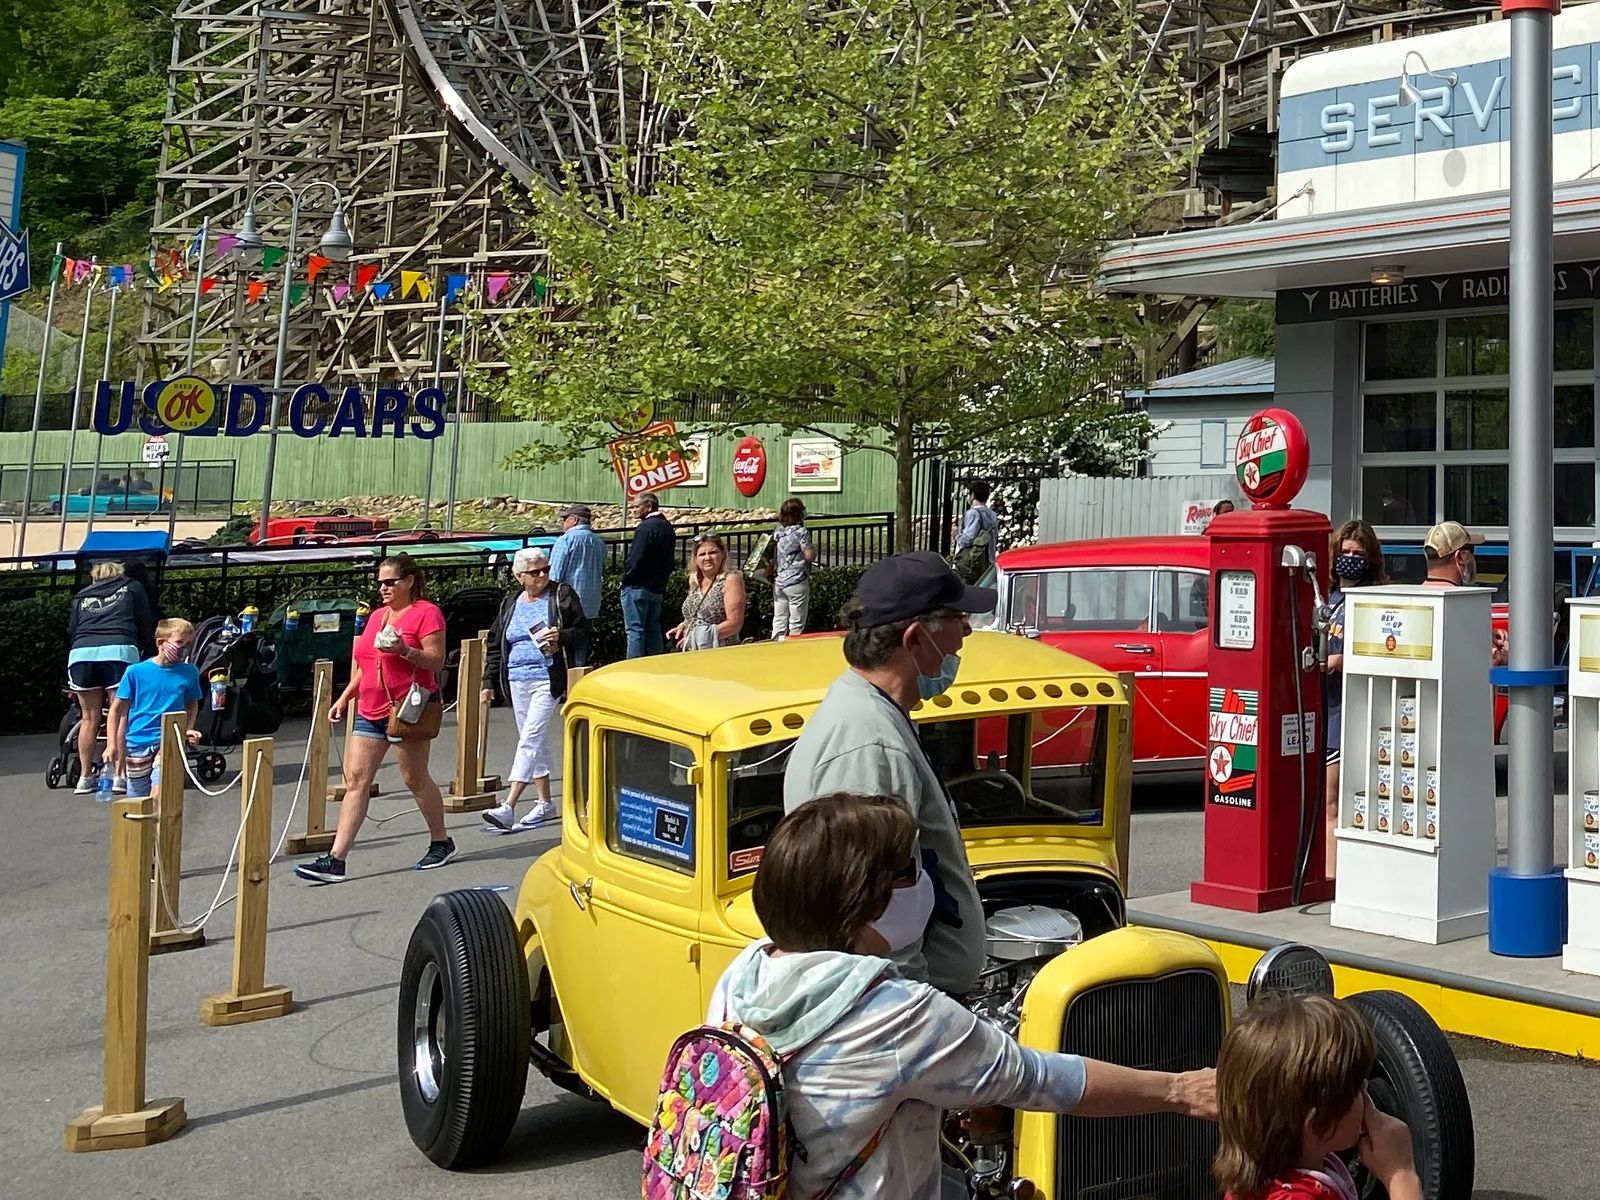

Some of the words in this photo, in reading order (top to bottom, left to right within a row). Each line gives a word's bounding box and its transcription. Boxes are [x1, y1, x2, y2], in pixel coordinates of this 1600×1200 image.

[1328, 283, 1419, 311] BATTERIES
[1462, 269, 1568, 300] RADIS
[92, 379, 267, 437] USD
[288, 382, 447, 440] CARS
[164, 384, 206, 422] OK
[1238, 437, 1252, 461] Sky
[1252, 426, 1278, 454] Chief
[628, 449, 673, 478] BU
[629, 460, 683, 492] ONE
[1380, 614, 1395, 622] REV
[1209, 713, 1227, 740] Sky
[1229, 715, 1258, 743] Chief
[1286, 727, 1311, 736] CONTNS
[1214, 794, 1252, 808] GASOLINE
